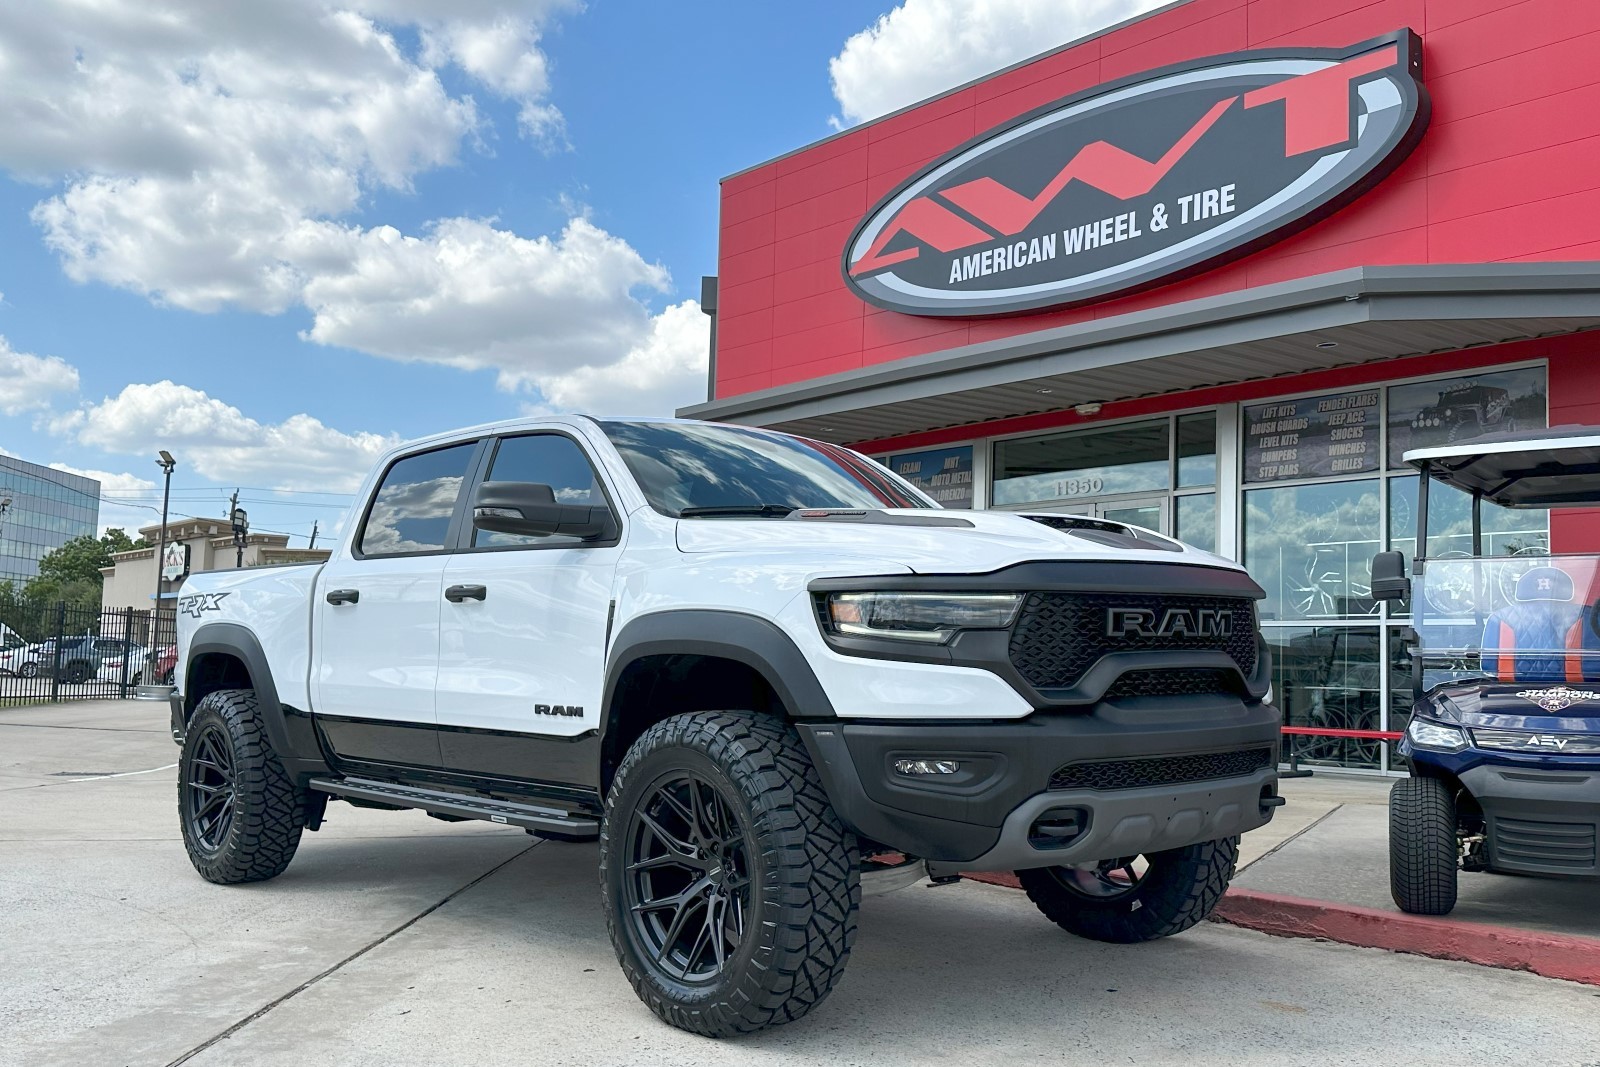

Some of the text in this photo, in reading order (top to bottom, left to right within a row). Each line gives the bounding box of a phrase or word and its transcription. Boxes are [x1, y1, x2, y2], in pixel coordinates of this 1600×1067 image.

[850, 47, 1398, 275] AWT
[948, 183, 1236, 284] AMERICAN WHEEL & TIRE
[1317, 394, 1378, 413] FENDER FLARES
[1262, 404, 1296, 419] LIFT KITS
[1328, 410, 1366, 427] JEEP ACC.
[1250, 417, 1309, 435] BRUSH GUARDS
[1330, 426, 1364, 441] SHOCKS
[1259, 433, 1299, 449] LEVEL KITS
[1328, 441, 1367, 456] WINCHES
[1260, 448, 1298, 463] BUMPERS
[899, 461, 922, 474] LEXANI
[1259, 463, 1299, 478] STEP BARS
[1331, 457, 1364, 472] GRILLES
[930, 470, 972, 487] MOTO METAL
[1055, 477, 1104, 496] 11350
[937, 487, 966, 502] LORENZO
[1106, 607, 1234, 638] RAM
[534, 703, 584, 718] RAM
